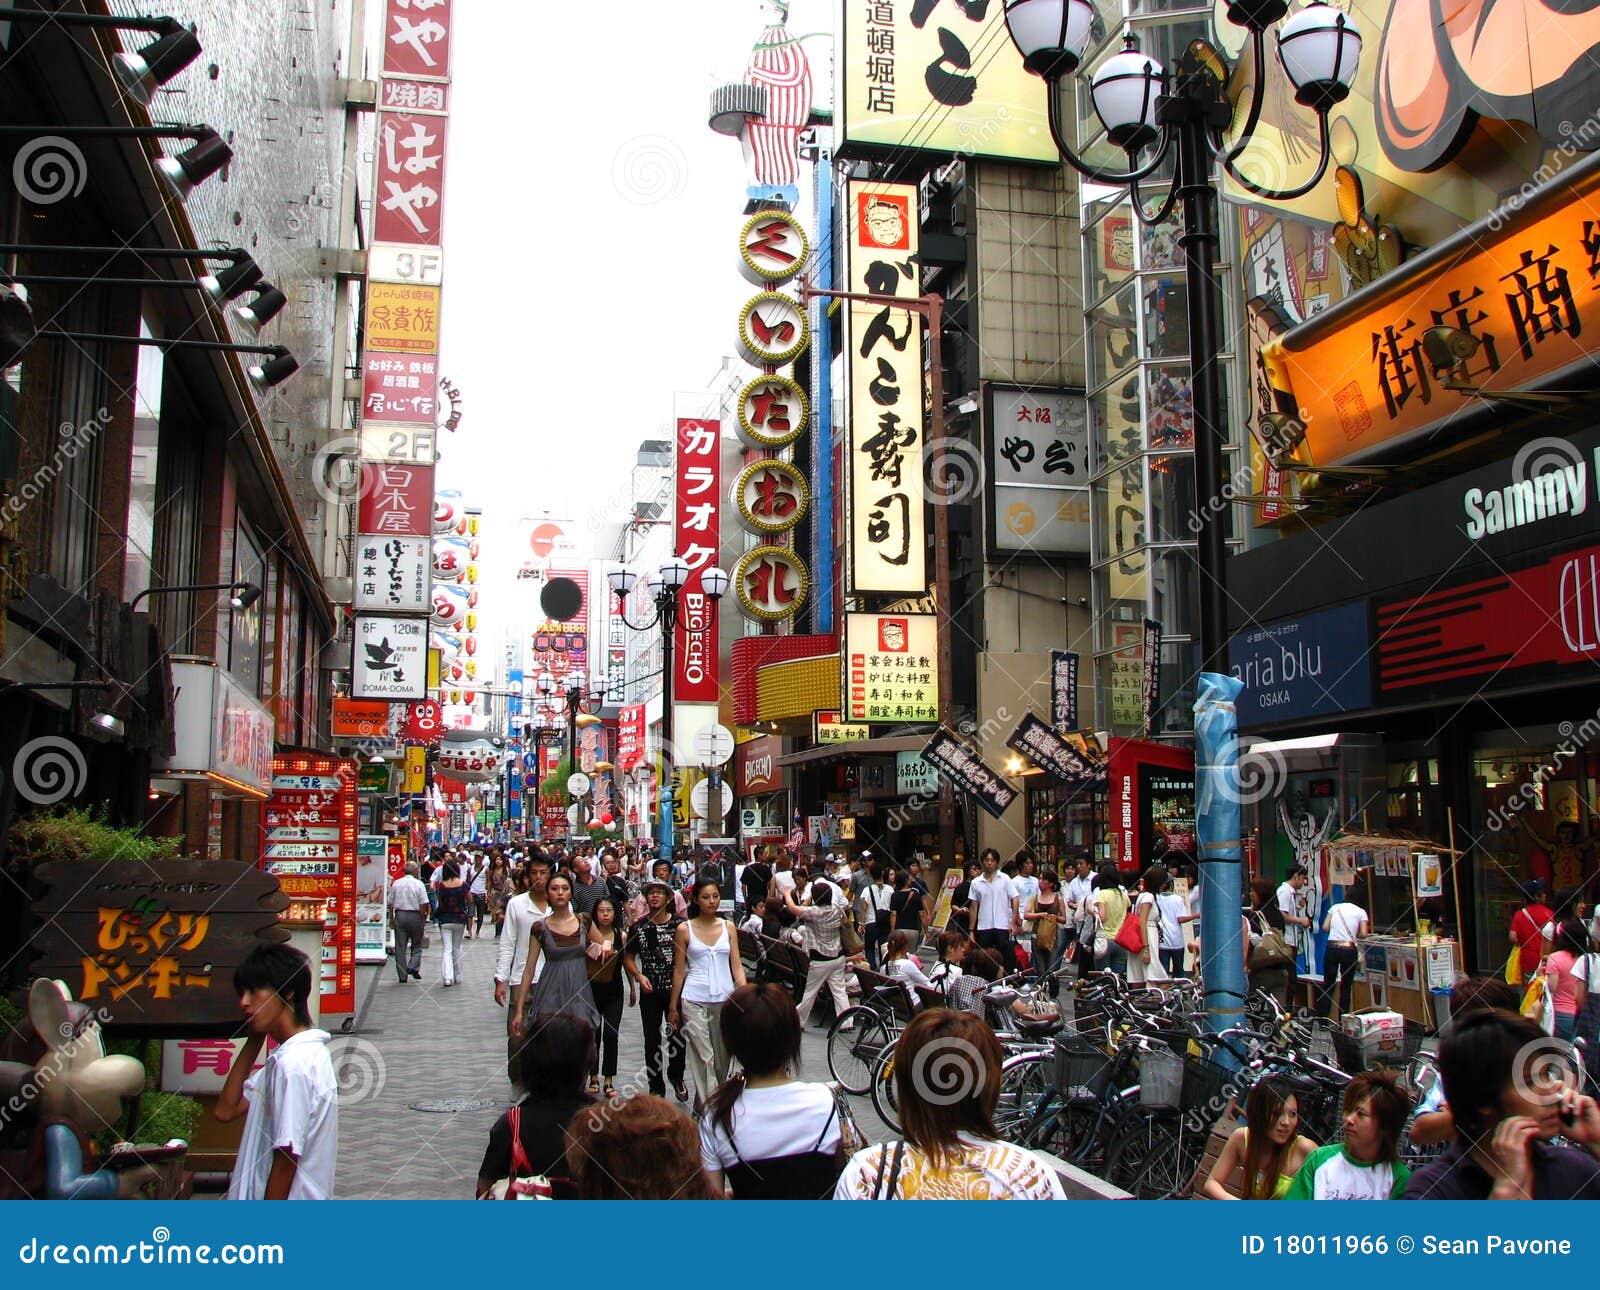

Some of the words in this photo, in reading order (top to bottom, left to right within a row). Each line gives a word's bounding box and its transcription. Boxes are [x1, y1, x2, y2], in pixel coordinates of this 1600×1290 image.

[390, 0, 448, 67] や
[866, 0, 895, 114] 道頓堀店
[386, 82, 443, 109] 焼肉
[380, 122, 442, 234] はや
[396, 253, 439, 279] 3F
[368, 360, 405, 372] お好み
[1017, 405, 1052, 424] 大阪
[388, 432, 433, 459] 2F
[376, 467, 416, 532] 白木屋
[682, 427, 716, 572] カラオケ
[1464, 461, 1587, 540] Sammy
[363, 623, 376, 633] 6F
[869, 656, 930, 668] 宴会お座敷
[1281, 642, 1323, 682] blu
[363, 685, 414, 693] DOMA-DOMA
[869, 673, 931, 684] 炉ばた料理
[1259, 689, 1291, 708] OSAKA
[1122, 775, 1131, 801] Plaza
[1122, 802, 1132, 828] EBISU
[1123, 831, 1134, 862] Sammy
[97, 906, 211, 954] びっくり
[79, 953, 214, 1001] ドンキー
